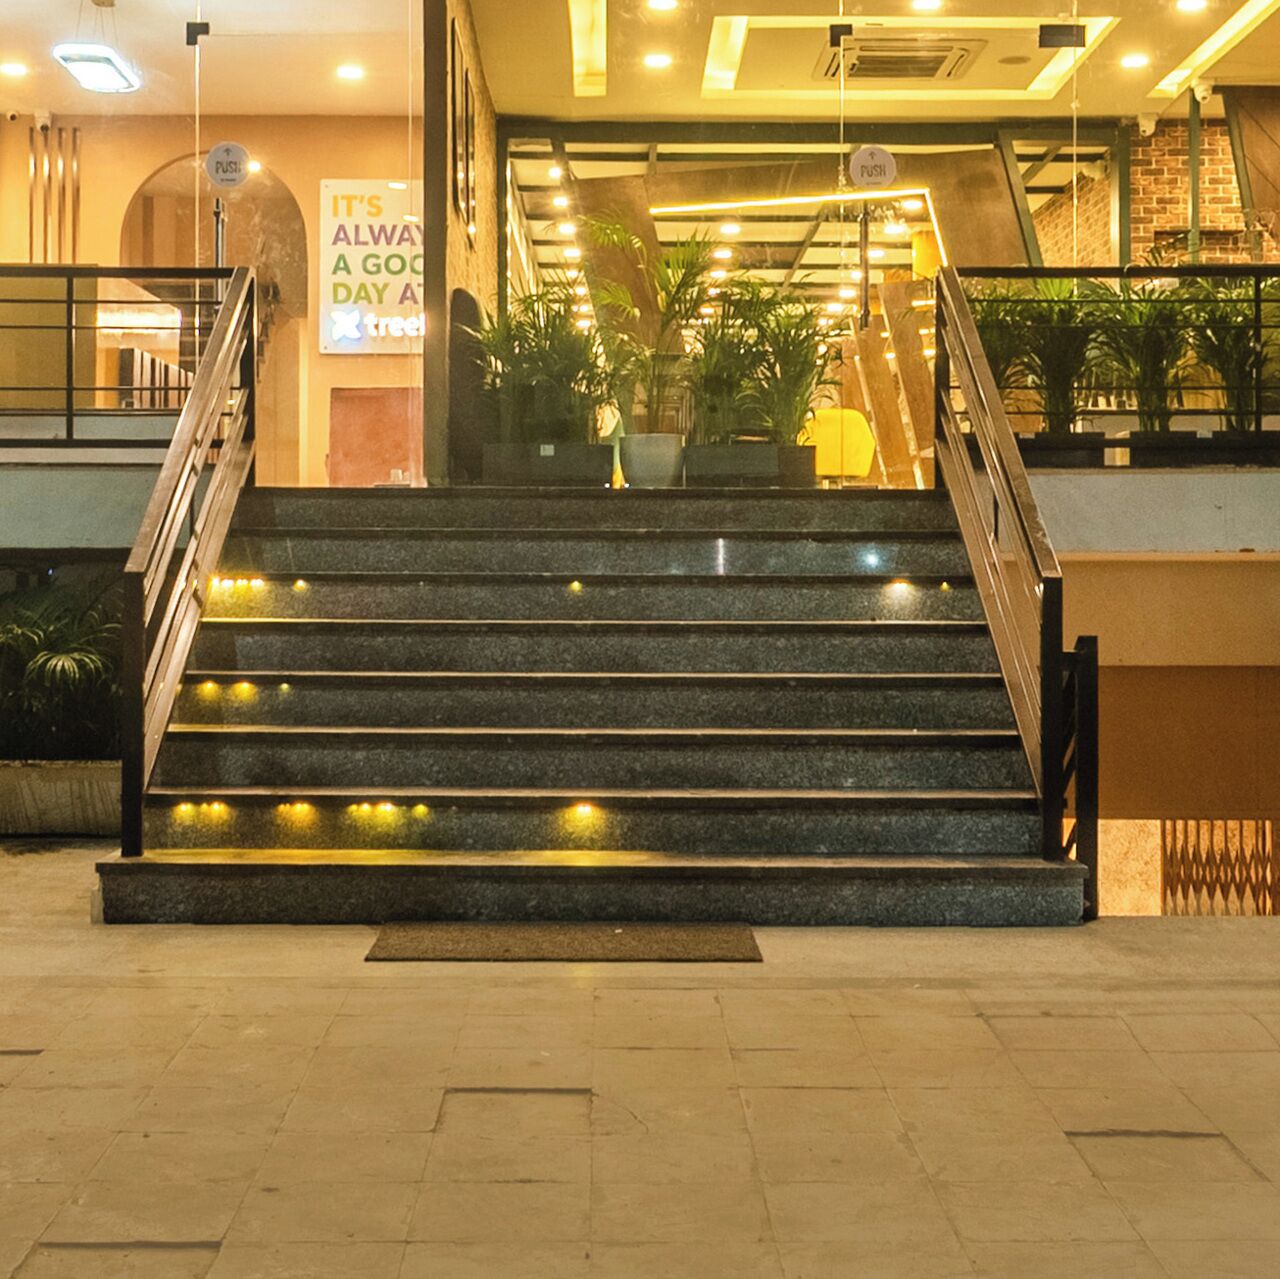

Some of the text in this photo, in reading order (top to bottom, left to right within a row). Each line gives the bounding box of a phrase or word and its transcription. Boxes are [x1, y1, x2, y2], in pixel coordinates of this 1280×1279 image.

[215, 160, 242, 174] PUSH
[860, 164, 886, 178] PUSH
[332, 194, 383, 218] IT'S
[331, 253, 352, 275] A
[332, 282, 389, 305] DAY
